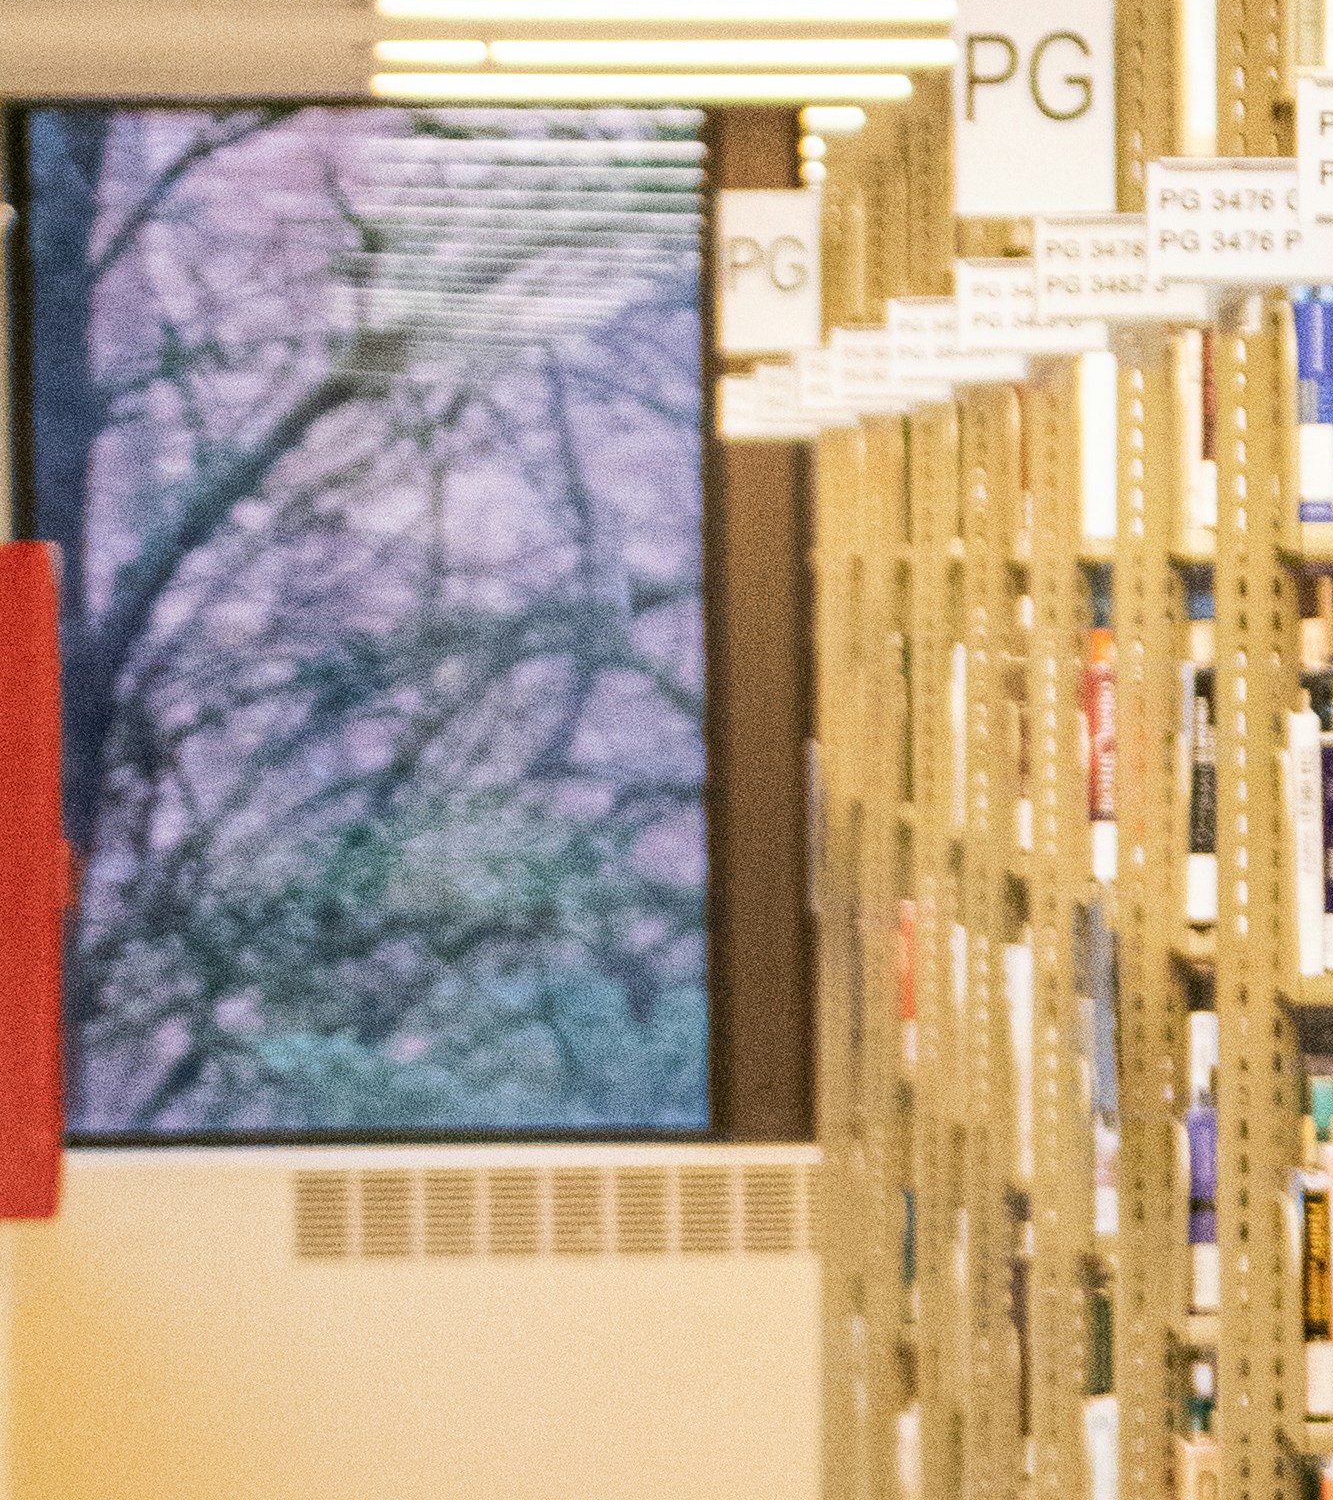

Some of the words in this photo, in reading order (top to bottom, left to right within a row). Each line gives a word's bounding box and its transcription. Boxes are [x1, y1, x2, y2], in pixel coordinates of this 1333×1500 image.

[964, 29, 1094, 124] PG
[1158, 189, 1201, 212] PG
[1212, 189, 1275, 212] 3476
[1045, 240, 1079, 261] PG
[1158, 230, 1200, 253] PG
[1212, 230, 1275, 253] 3476
[1284, 229, 1304, 251] P
[726, 235, 808, 294] PG
[1045, 277, 1081, 297] PG
